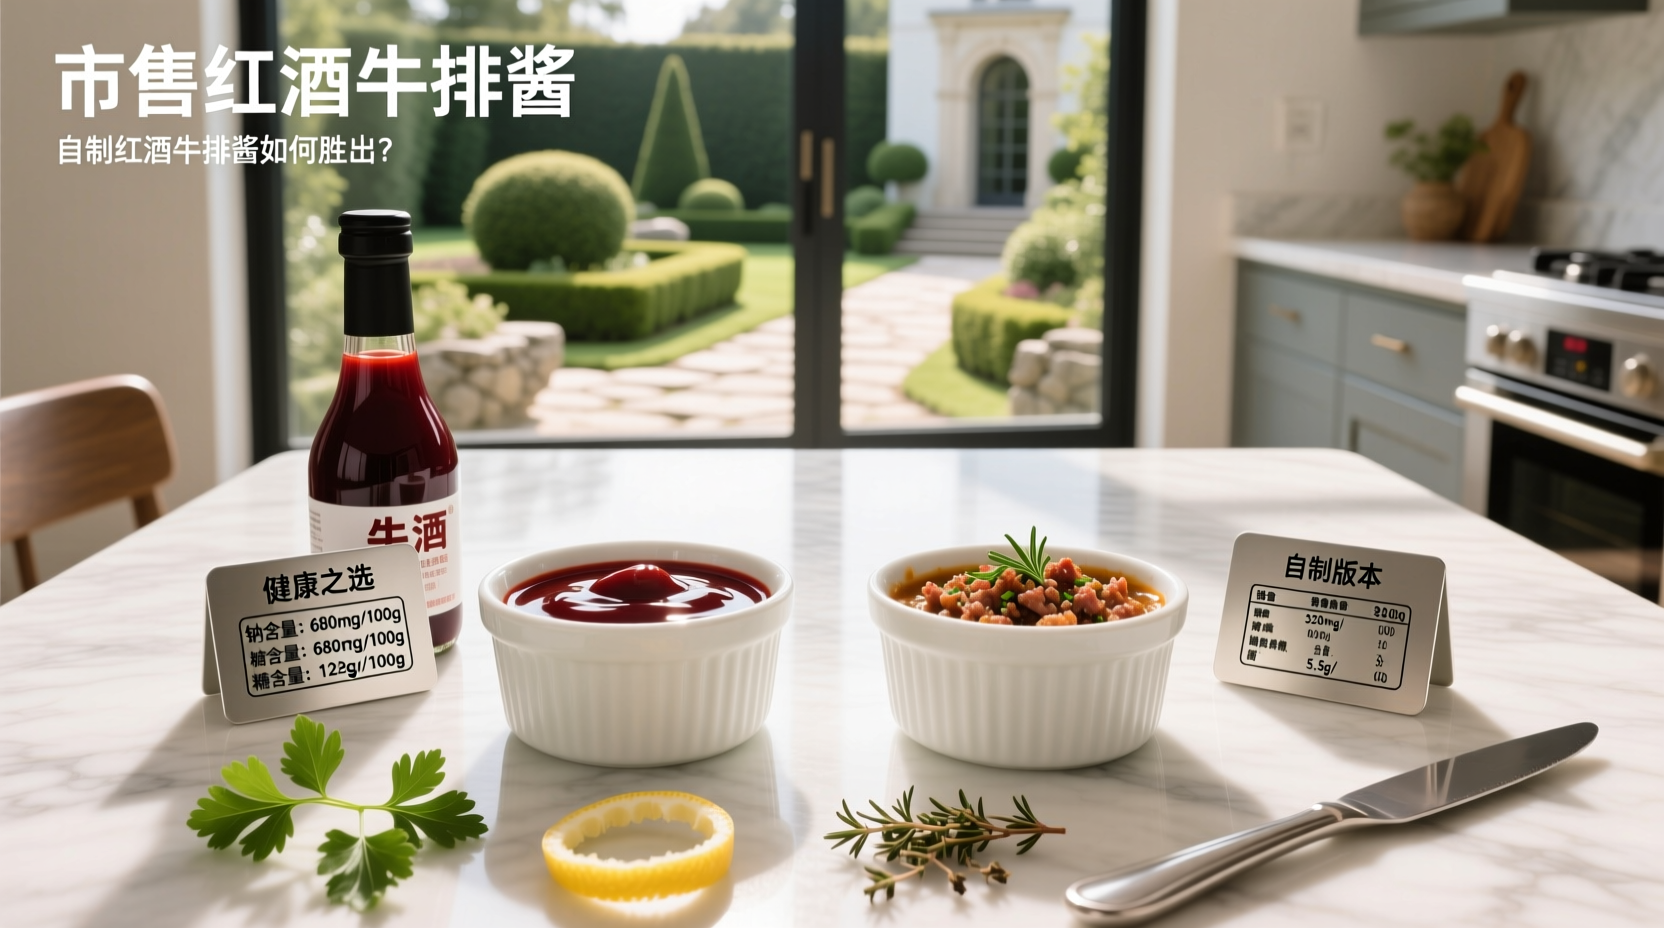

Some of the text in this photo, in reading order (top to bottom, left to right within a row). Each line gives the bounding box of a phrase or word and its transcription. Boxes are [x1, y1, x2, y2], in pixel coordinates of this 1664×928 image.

[263, 563, 375, 605] 健康之选
[1285, 553, 1382, 589] 自制版本
